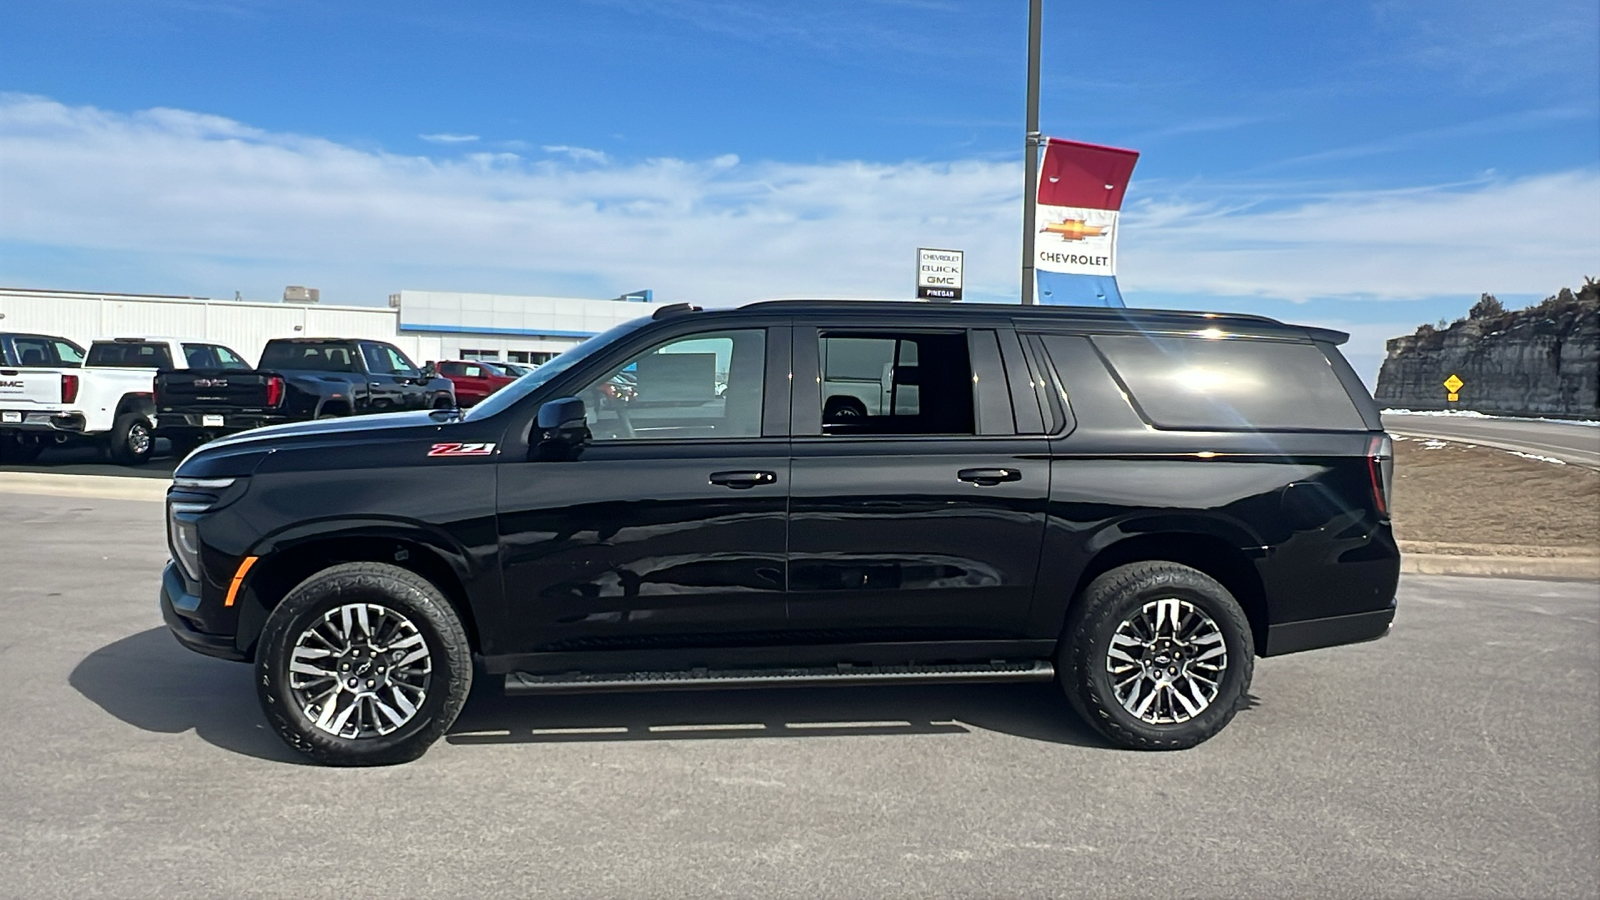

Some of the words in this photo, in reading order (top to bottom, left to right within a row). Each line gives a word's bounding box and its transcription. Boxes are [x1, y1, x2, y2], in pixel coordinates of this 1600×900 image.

[923, 254, 959, 262] CHEVROLET
[1040, 252, 1108, 266] CHEVROLET
[922, 265, 959, 273] BUICK
[927, 276, 954, 284] GMC
[427, 443, 496, 456] Z71
